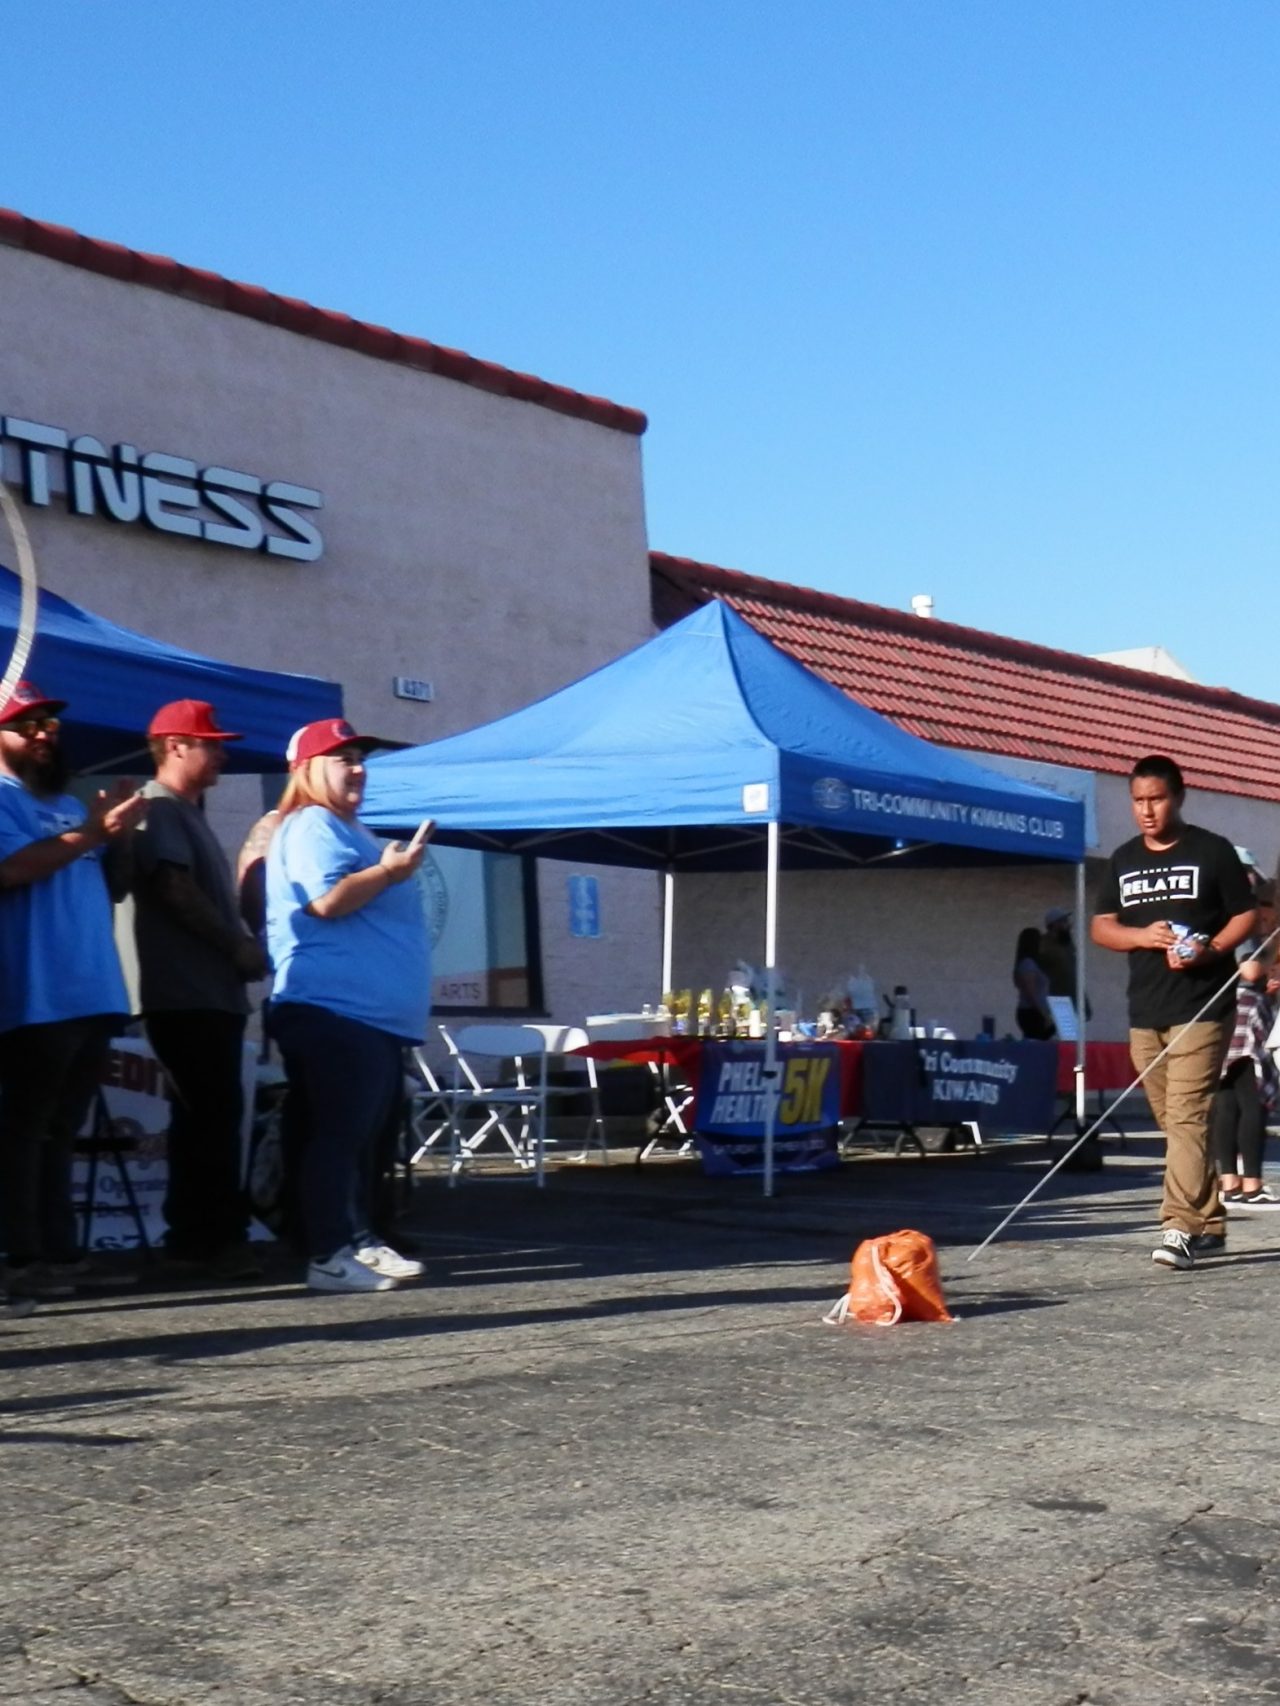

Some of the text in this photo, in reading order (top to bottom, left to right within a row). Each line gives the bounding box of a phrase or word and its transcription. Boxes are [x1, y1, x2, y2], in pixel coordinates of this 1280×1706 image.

[0, 416, 324, 562] TNESS
[851, 788, 1065, 839] TRI-COMMUNITY KIWANIS CLUB
[1122, 875, 1191, 898] RELATE
[440, 982, 481, 1000] ARTS
[919, 1048, 938, 1072] ri
[779, 1057, 832, 1126] 5K
[932, 1079, 999, 1105] KIWANIS
